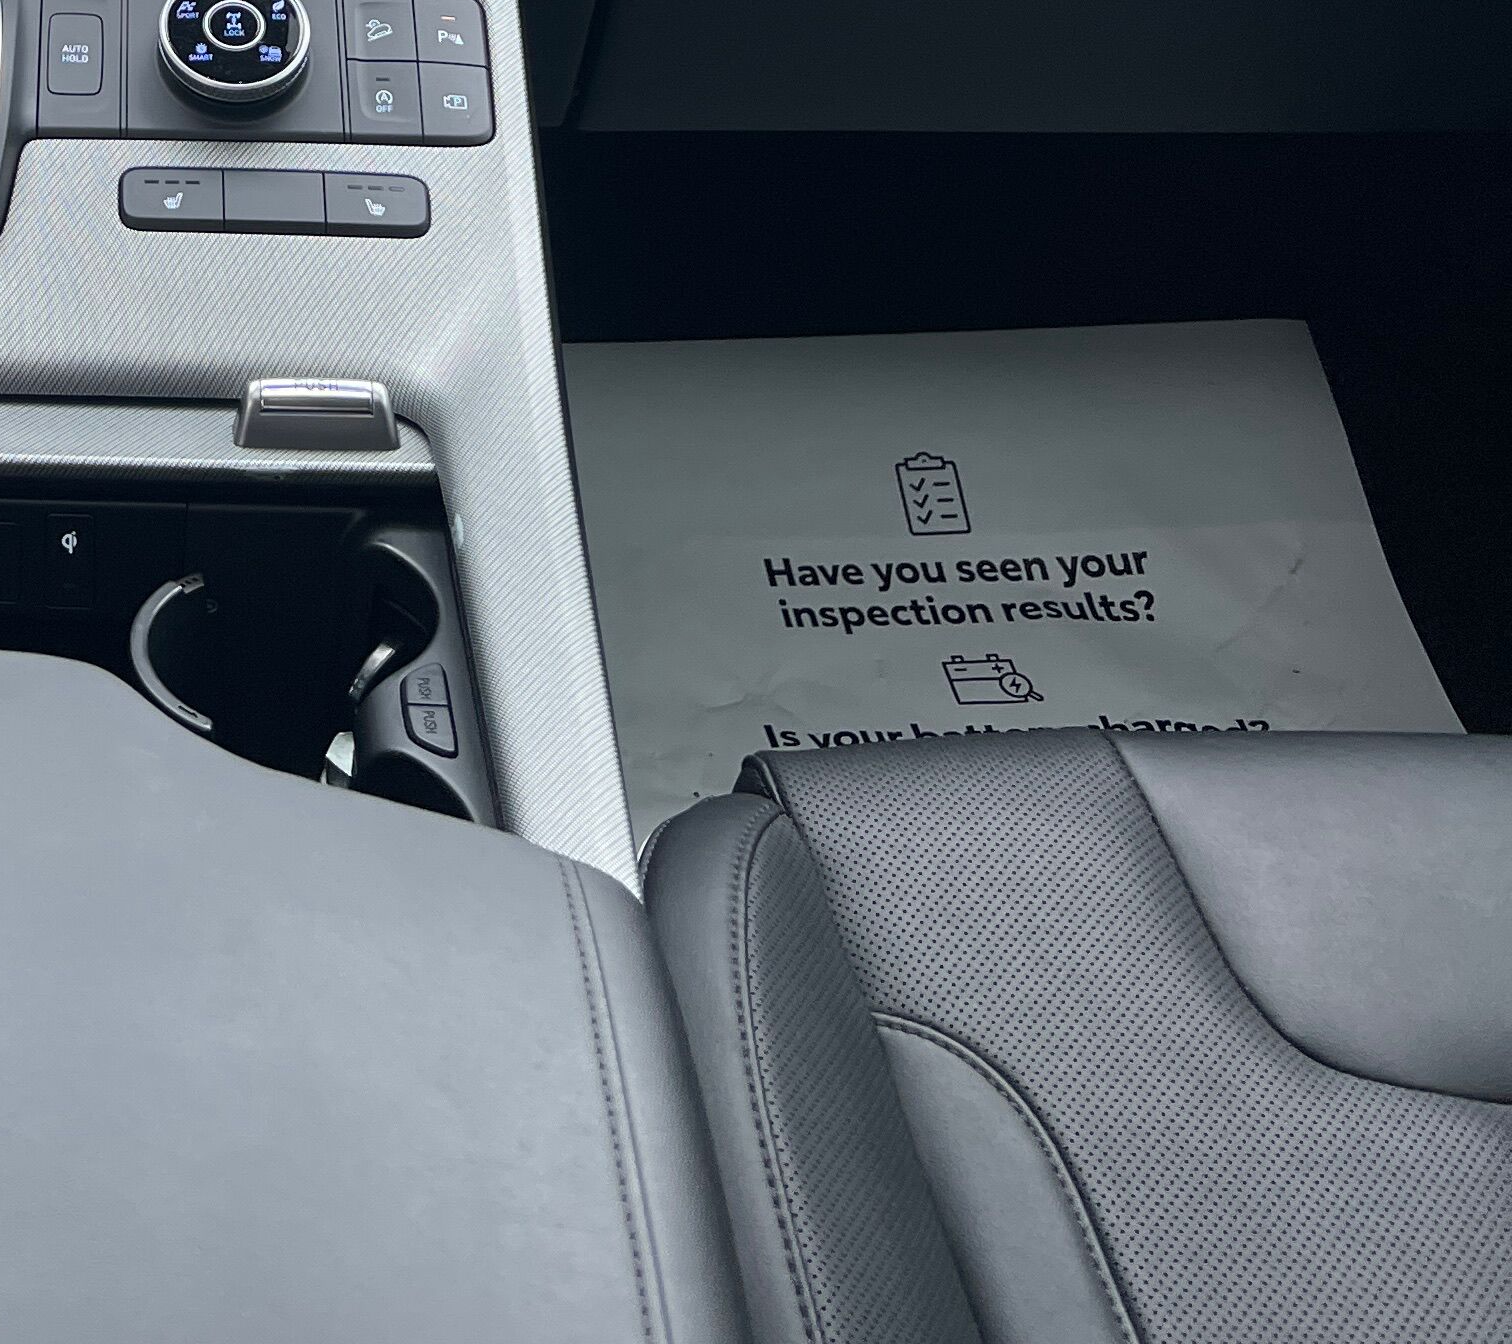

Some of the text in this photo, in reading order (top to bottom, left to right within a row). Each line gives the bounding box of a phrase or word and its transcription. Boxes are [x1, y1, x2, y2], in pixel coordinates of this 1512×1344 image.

[176, 12, 199, 20] SPORT
[223, 29, 245, 37] LOCK
[62, 45, 89, 53] AUTO
[62, 54, 89, 63] HOLD
[188, 53, 213, 62] SMART
[376, 105, 393, 113] OFF
[294, 380, 340, 391] PUSH
[763, 549, 1148, 592] Have you seen your
[778, 590, 1156, 634] inspection results?
[416, 677, 432, 700] PUSH
[422, 710, 438, 735] PUSH
[763, 724, 801, 748] Is
